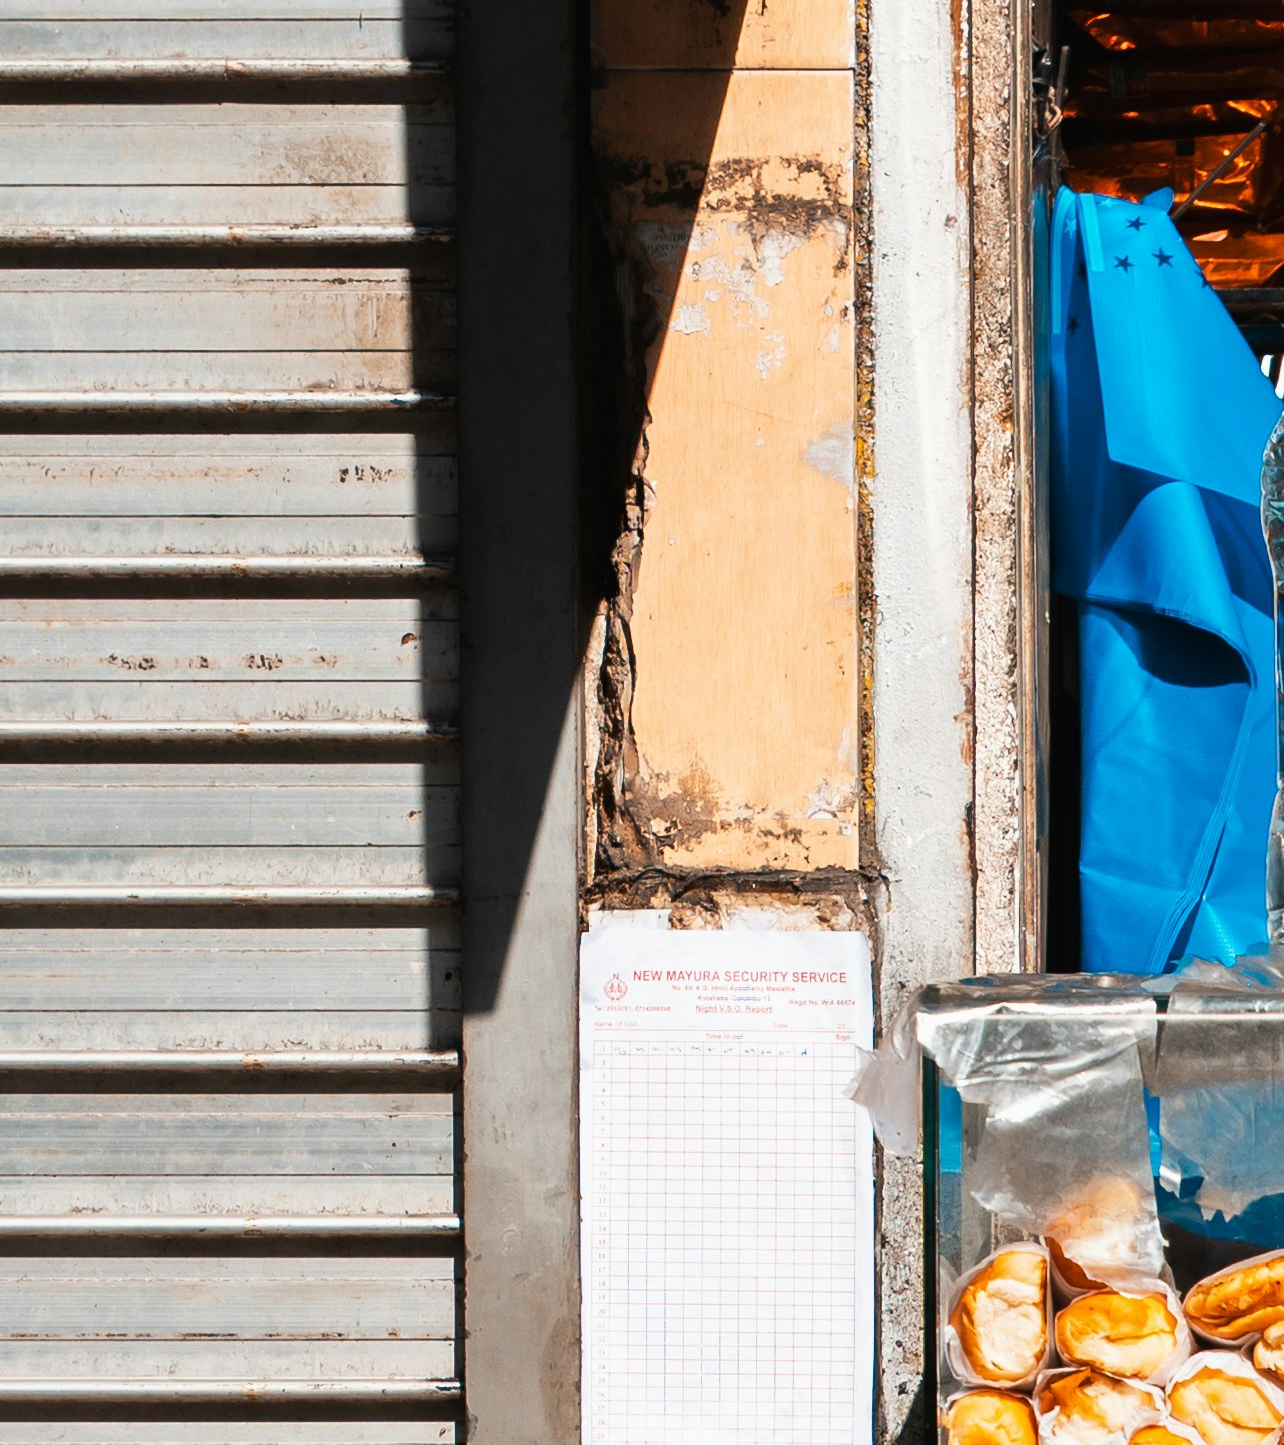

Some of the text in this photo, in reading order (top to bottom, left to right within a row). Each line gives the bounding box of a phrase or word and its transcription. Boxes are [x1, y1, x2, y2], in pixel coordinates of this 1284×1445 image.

[633, 970, 847, 984] NEW MAYURA SECURITY SERVICE
[696, 1005, 718, 1014] Night
[746, 1005, 773, 1014] Report
